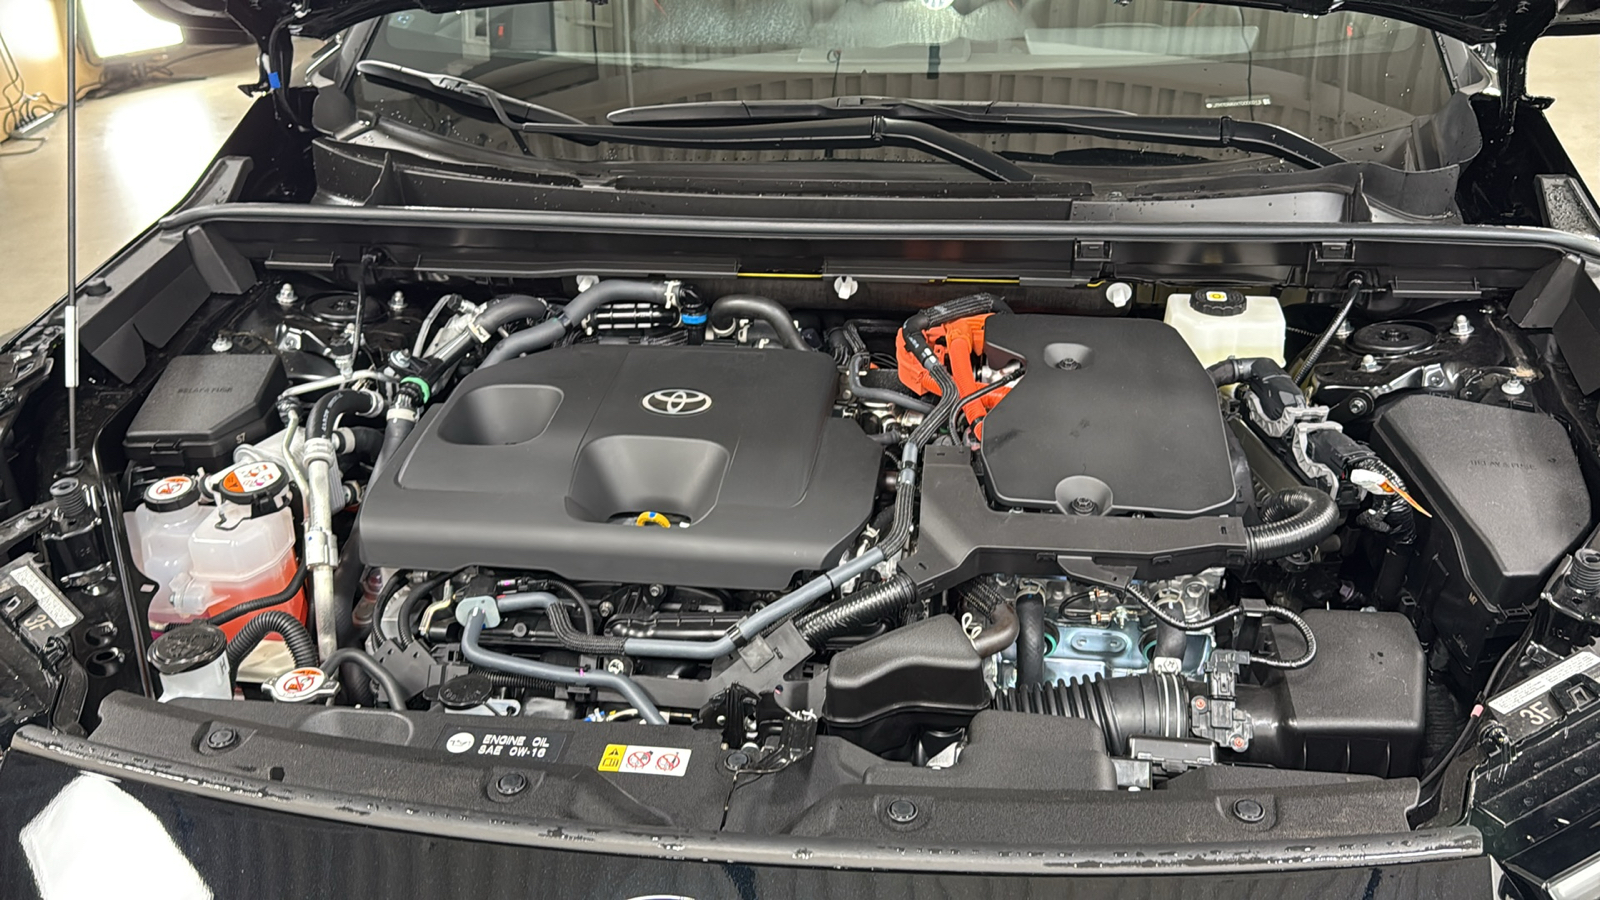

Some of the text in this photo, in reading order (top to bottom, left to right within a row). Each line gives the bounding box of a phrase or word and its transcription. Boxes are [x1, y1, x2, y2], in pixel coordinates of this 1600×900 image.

[23, 614, 55, 631] 3F
[1519, 700, 1552, 726] 3F
[482, 733, 527, 746] ENGINE
[531, 736, 550, 748] OIL
[477, 744, 504, 756] SAE
